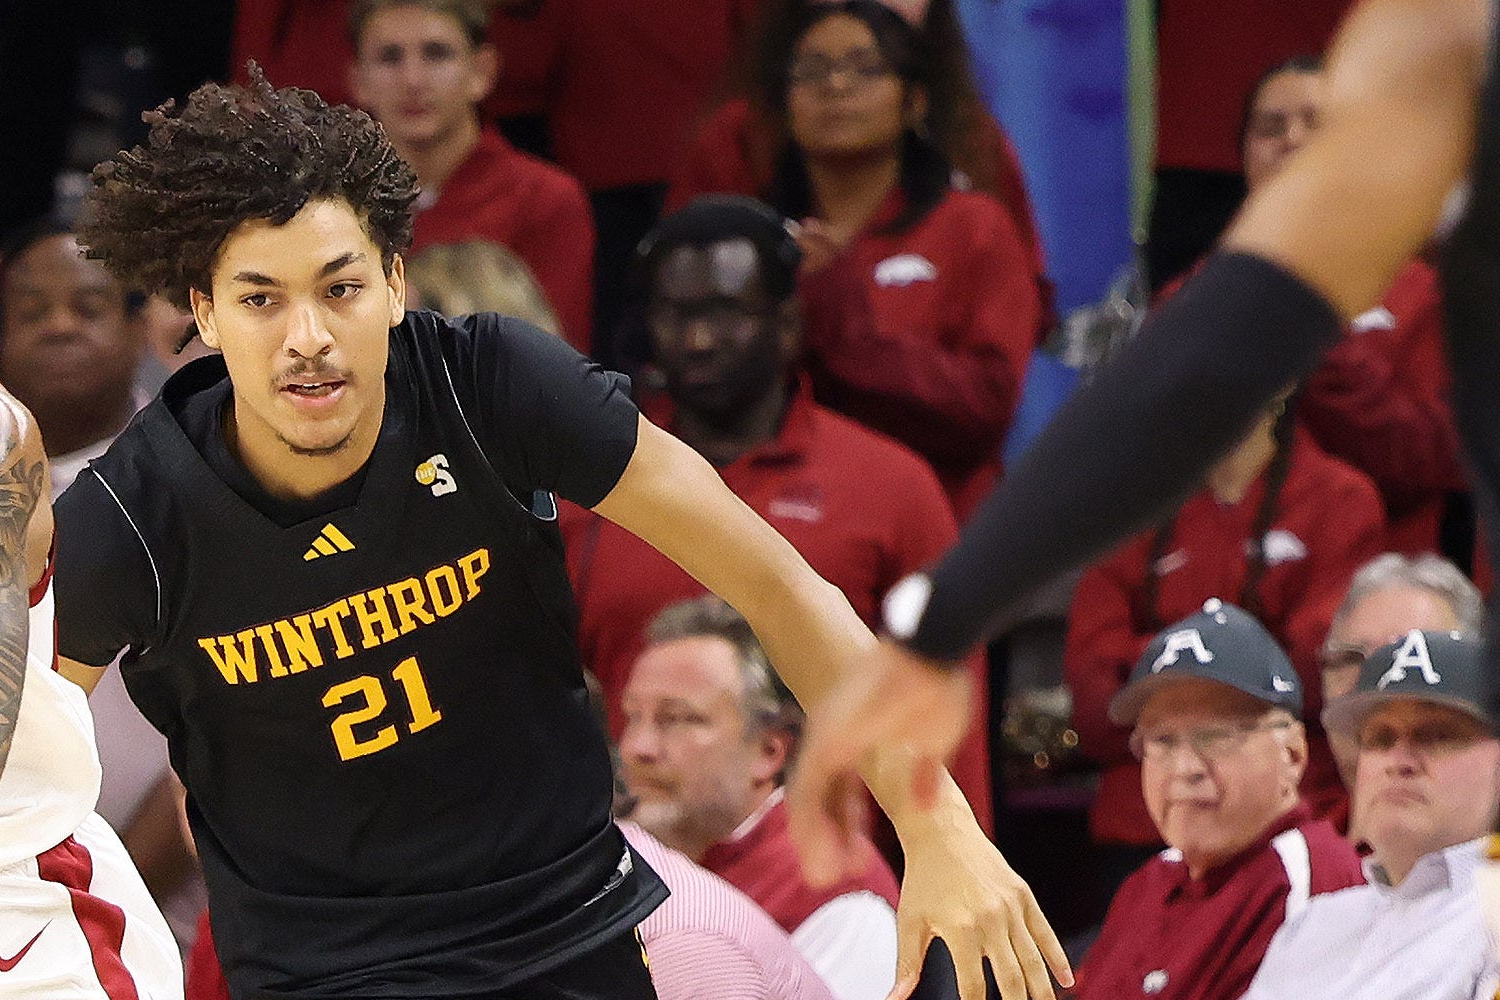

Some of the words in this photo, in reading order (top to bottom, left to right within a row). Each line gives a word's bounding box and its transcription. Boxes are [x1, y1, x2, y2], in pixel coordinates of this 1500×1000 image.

[197, 547, 490, 685] WINTHROP
[1376, 627, 1441, 690] A
[321, 656, 443, 762] 21
